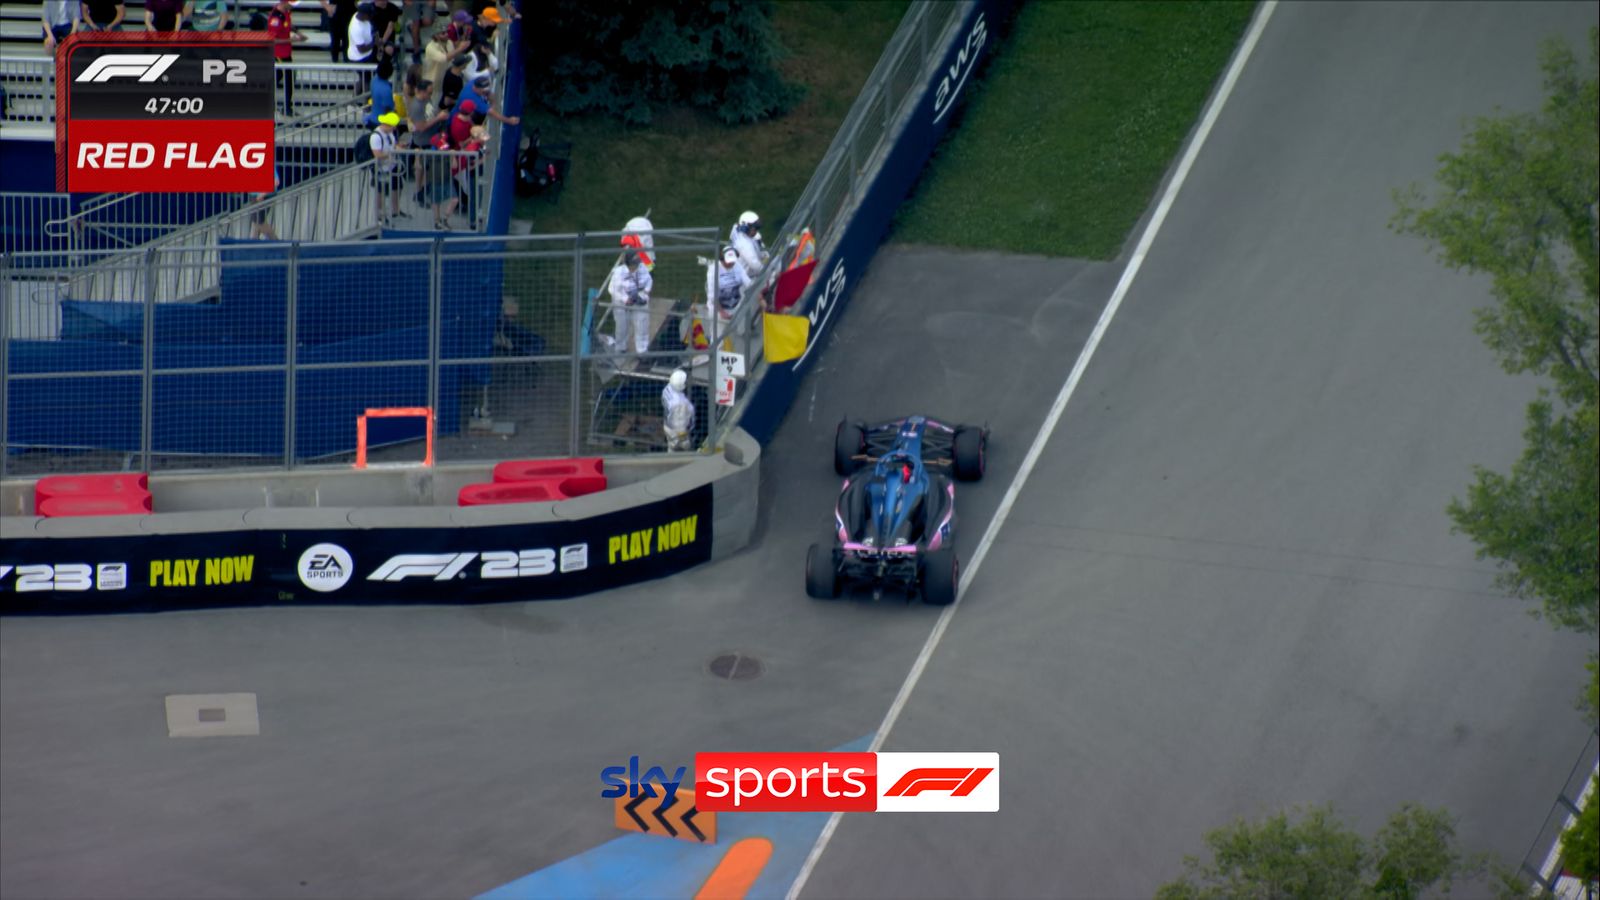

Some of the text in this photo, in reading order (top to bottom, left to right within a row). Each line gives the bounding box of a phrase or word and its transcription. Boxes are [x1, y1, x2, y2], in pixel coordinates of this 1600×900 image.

[808, 257, 846, 327] ws
[721, 356, 738, 365] MP
[608, 528, 653, 564] PLAY
[657, 514, 698, 552] NOW
[150, 559, 199, 587] PLAY
[205, 555, 255, 585] NOW
[307, 570, 344, 579] SPORTS
[308, 554, 342, 570] EA
[481, 548, 556, 579] 23
[15, 564, 92, 592] 23
